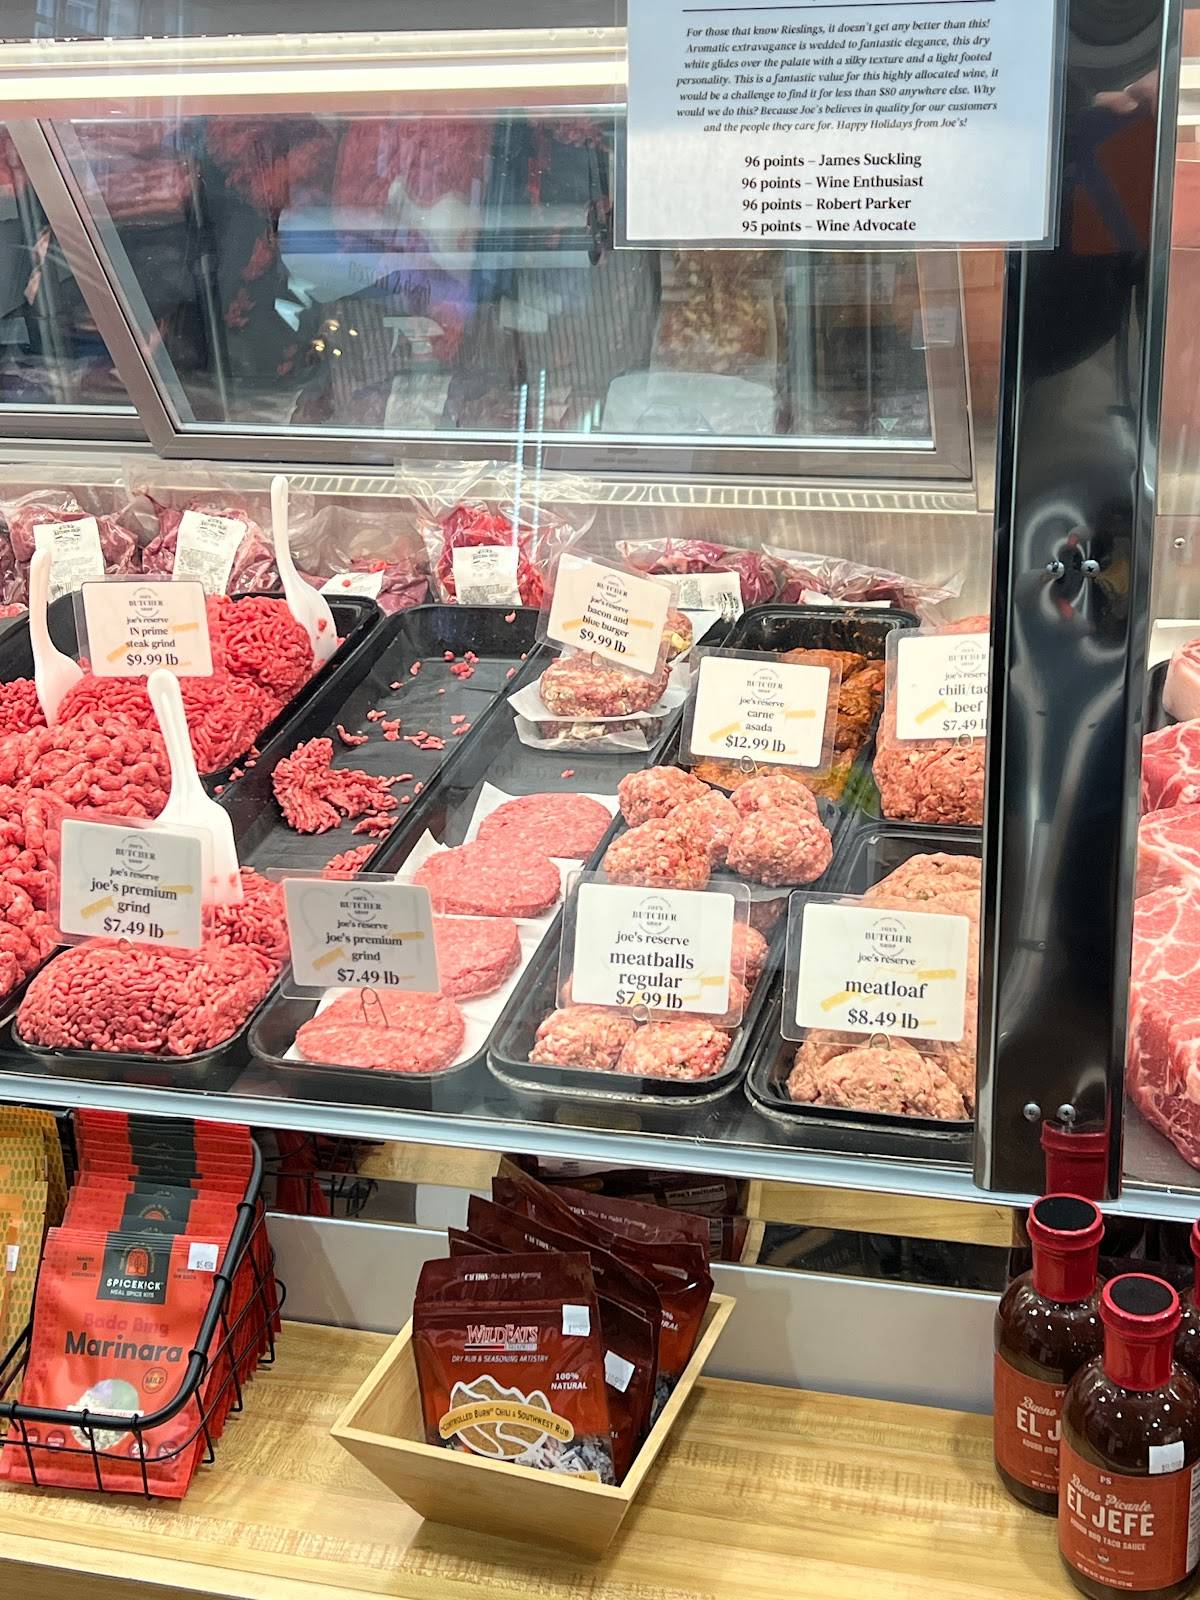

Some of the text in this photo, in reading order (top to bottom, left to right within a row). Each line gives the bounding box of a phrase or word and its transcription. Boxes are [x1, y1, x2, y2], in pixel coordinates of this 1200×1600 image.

[704, 19, 990, 36] those that know Rieslings, doesn't better than this!
[686, 36, 970, 54] Aromatic extravagance wedded fantastic elegance, this
[683, 51, 992, 71] white glides over palate with silky texture light footed
[675, 68, 989, 88] personality. This fantastic value for this highly allocated wine,
[679, 84, 996, 103] would challenge find for less than $80 anywhere else. Why
[676, 107, 705, 116] would
[736, 106, 758, 116] this?
[760, 106, 798, 115] Because
[799, 104, 823, 114] Joe's
[824, 104, 862, 114] believes
[875, 103, 909, 115] quality
[909, 102, 927, 114] for
[947, 103, 998, 111] customers
[703, 123, 722, 132] and
[723, 122, 738, 131] the
[739, 122, 770, 134] people
[772, 122, 793, 133] they
[814, 120, 834, 133] for.
[836, 120, 868, 132] Happy
[870, 119, 913, 131] Holidays
[912, 118, 939, 131] from
[940, 118, 967, 127] Joe's!
[745, 152, 922, 171] 96 points James Suckling
[742, 174, 924, 192] 96 points Wine Enthusiast
[742, 197, 911, 214] 96 points Robert Parker
[742, 219, 916, 236] 95 points Wine Advocate
[587, 605, 629, 625] bacon and
[130, 627, 168, 637] IN prime
[582, 615, 629, 638] blue burger
[126, 639, 176, 650] steak grind
[579, 628, 626, 654] $9.99 lb
[126, 653, 178, 666] $9.99 lb
[757, 699, 785, 708] reserve
[954, 701, 983, 713] beef
[747, 711, 774, 720] carne
[745, 722, 772, 732] asada
[942, 720, 977, 731] $7.49
[725, 734, 786, 753] $12.99 lb
[115, 848, 156, 860] BUTCHER
[109, 867, 160, 881] joe's reserve
[90, 878, 177, 901] joe's premium
[117, 901, 151, 914] grind
[339, 901, 382, 910] BUTCHER
[337, 920, 357, 929] joe's
[632, 911, 677, 922] BUTCHER
[103, 916, 164, 939] $7.49 lb
[325, 933, 403, 946] joe's premium
[615, 931, 690, 946] joe's reserve
[865, 932, 912, 944] BUTCHER
[351, 951, 381, 961] grind
[609, 952, 695, 969] meatballs
[857, 952, 916, 965] joe's reserve
[337, 968, 399, 985] $7.49 lb
[618, 972, 683, 990] regular
[845, 980, 928, 999] meatloaf
[615, 990, 683, 1009] $7.99 lb
[848, 1008, 919, 1029] $8.49 lb
[106, 1278, 161, 1290] SPICEKICK
[83, 1313, 169, 1337] Bada Bing
[65, 1331, 184, 1362] Marinara
[452, 1355, 549, 1363] DRY SEASONING ARTISTRY
[555, 1373, 579, 1381] 100%
[551, 1382, 588, 1390] NATURAL
[1020, 1396, 1056, 1417] Bueno
[1016, 1406, 1041, 1438] EL
[1100, 1475, 1112, 1485] PS
[1070, 1473, 1151, 1513] Bueno Picante
[1067, 1483, 1087, 1520] EL
[1092, 1506, 1154, 1537] JEFE
[1103, 1537, 1146, 1551] TACO SAUCE
